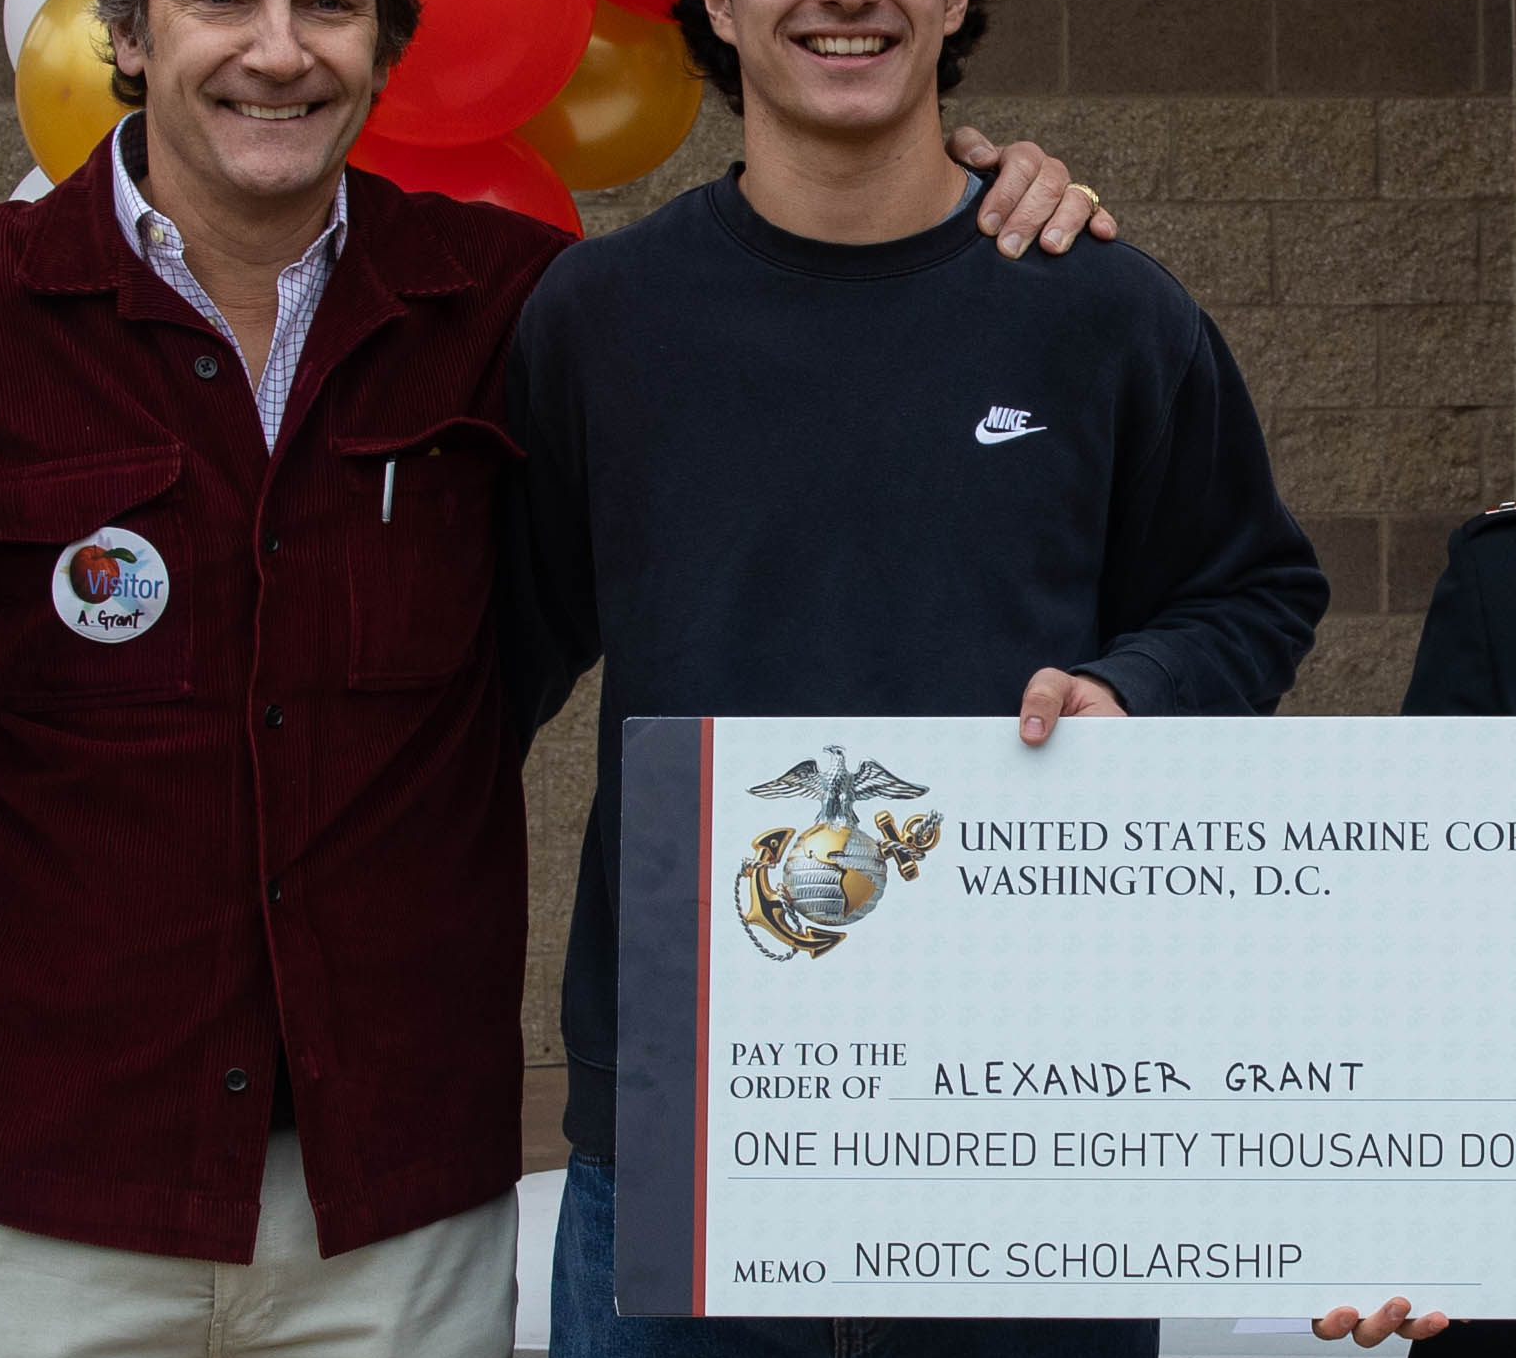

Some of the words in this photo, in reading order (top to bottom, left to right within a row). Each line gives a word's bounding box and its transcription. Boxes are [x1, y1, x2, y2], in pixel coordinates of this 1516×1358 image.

[985, 405, 1032, 431] NIKE
[86, 568, 165, 600] Visitor
[77, 609, 95, 626] A.
[97, 608, 146, 631] Grant
[960, 821, 1108, 852] UNITED
[1124, 821, 1266, 852] STATES
[1283, 821, 1430, 852] MARINE
[958, 865, 1235, 899] WASHINGTON,
[1254, 865, 1331, 896] D.C.
[731, 1043, 784, 1066] PAY
[794, 1043, 838, 1066] TO
[849, 1043, 907, 1066] THE
[730, 1075, 832, 1099] ORDER
[842, 1076, 881, 1100] OF
[933, 1060, 1191, 1098] ALEXANDER
[1225, 1061, 1364, 1094] GRANT
[734, 1131, 818, 1166] ONE
[834, 1132, 1036, 1167] HUNDRED
[1054, 1132, 1199, 1168] EIGHTY
[1210, 1132, 1443, 1168] THOUSAND
[733, 1260, 826, 1284] MEMO
[856, 1242, 990, 1278] NROTC
[1006, 1242, 1302, 1279] SCHOLARSHIP
